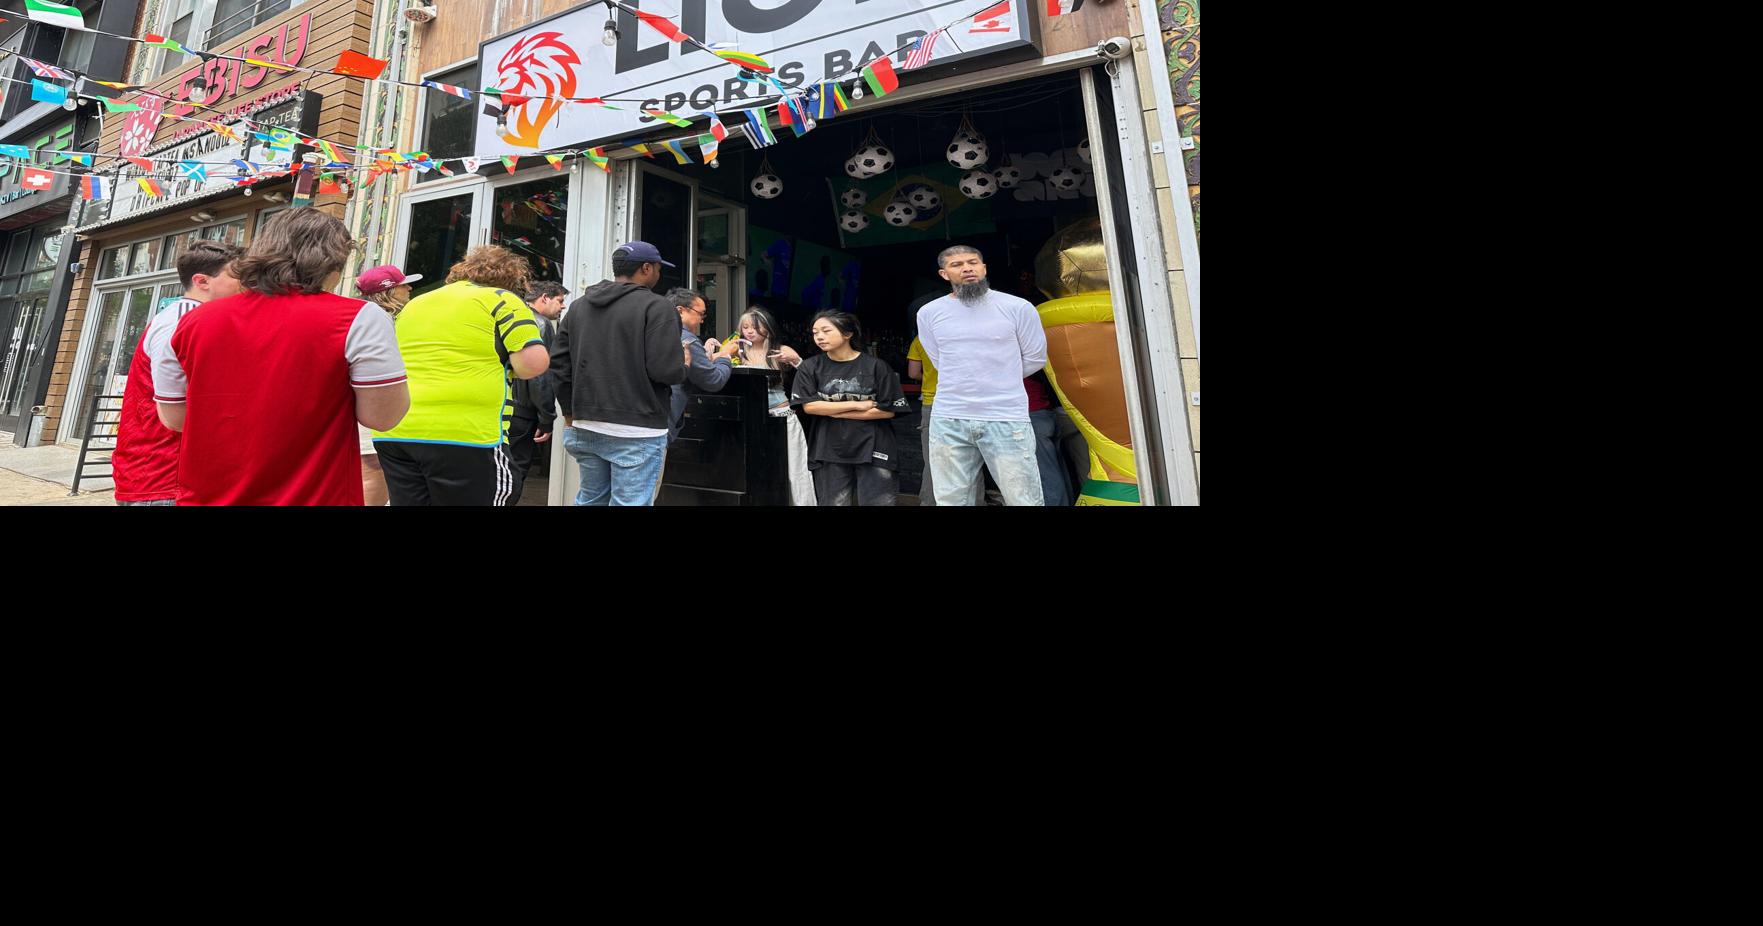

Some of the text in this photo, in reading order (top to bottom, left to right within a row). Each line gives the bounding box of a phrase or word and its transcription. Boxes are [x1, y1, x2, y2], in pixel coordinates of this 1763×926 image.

[175, 12, 312, 119] EBISU
[616, 0, 868, 74] LI
[639, 62, 805, 123] SPORTS
